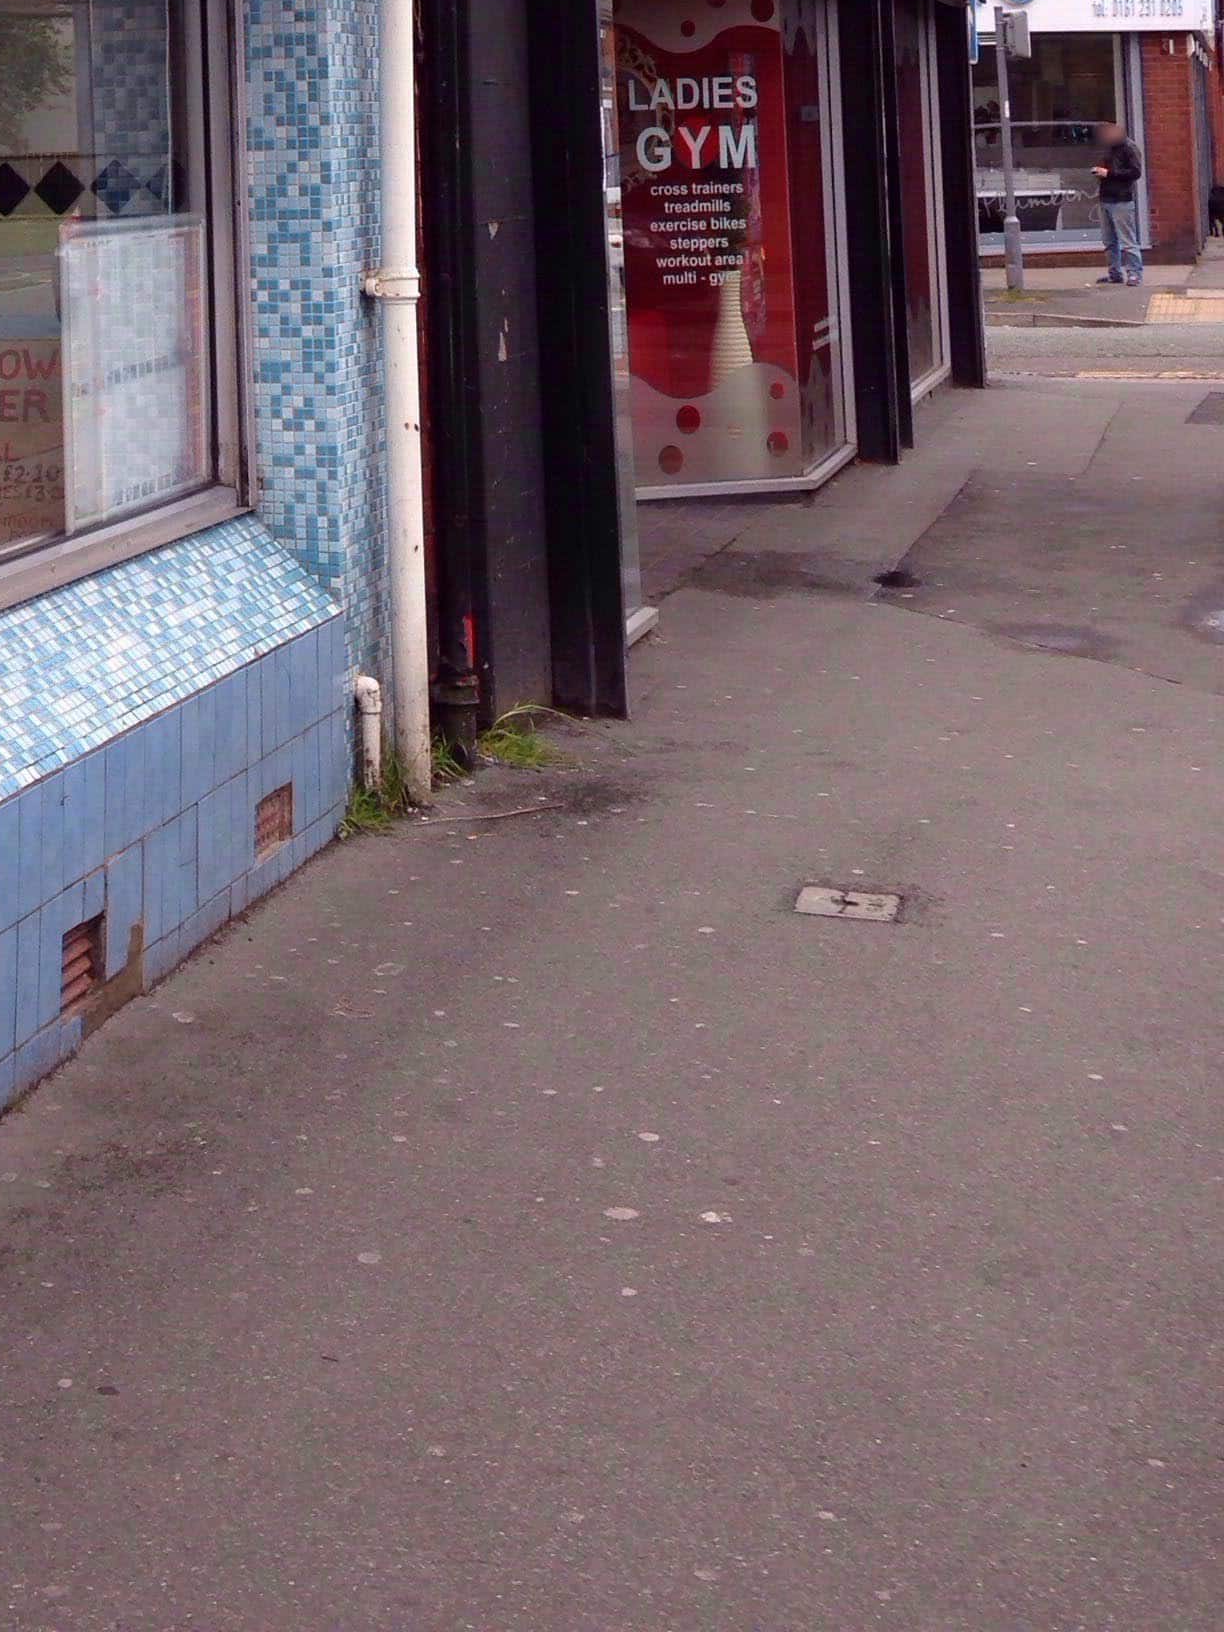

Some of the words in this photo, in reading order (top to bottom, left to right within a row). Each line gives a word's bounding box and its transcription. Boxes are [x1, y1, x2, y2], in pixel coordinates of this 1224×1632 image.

[628, 75, 758, 111] LADIES
[636, 124, 756, 172] GYM
[650, 183, 688, 196] cross
[691, 181, 744, 195] trainers
[664, 199, 731, 214] treadmills
[650, 218, 707, 232] exercise
[710, 216, 747, 230] bikes
[670, 236, 729, 252] steppers
[656, 254, 713, 268] workout
[714, 254, 744, 266] area
[663, 270, 697, 285] multi
